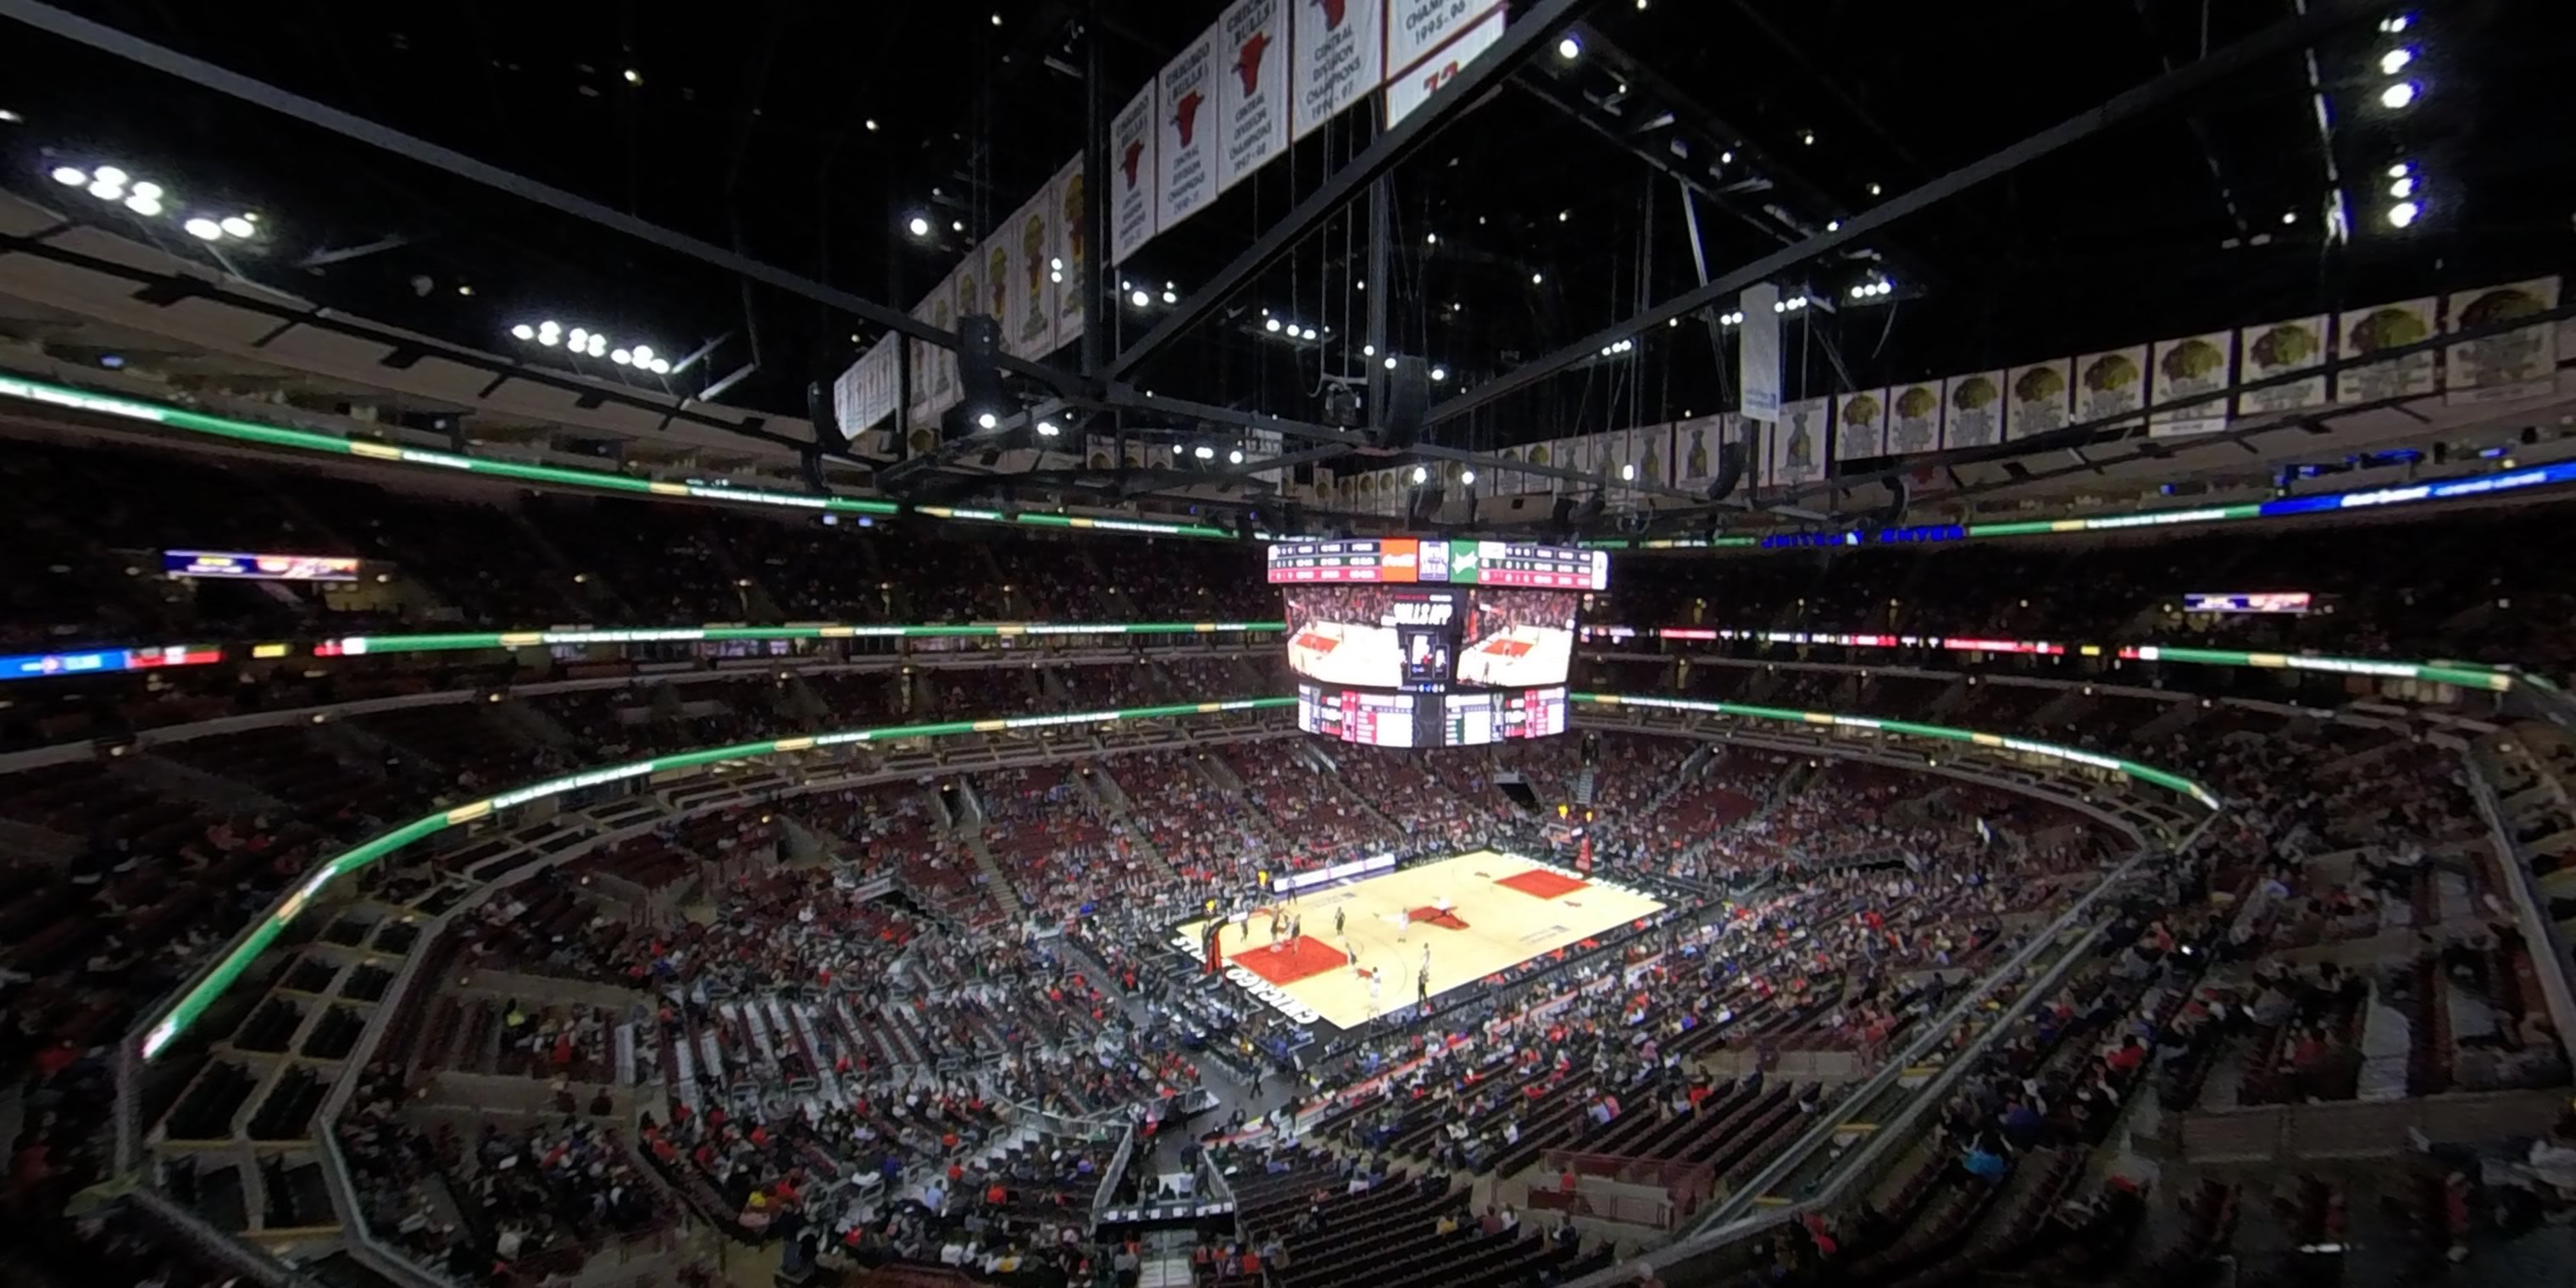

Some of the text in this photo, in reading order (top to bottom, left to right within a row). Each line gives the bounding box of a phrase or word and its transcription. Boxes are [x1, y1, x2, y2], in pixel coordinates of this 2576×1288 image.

[1313, 42, 1355, 82] DIVISION
[1314, 23, 1353, 62] CENTRAL
[1306, 56, 1361, 105] CHAMPIONS
[1226, 969, 1319, 1024] CHICAGO
